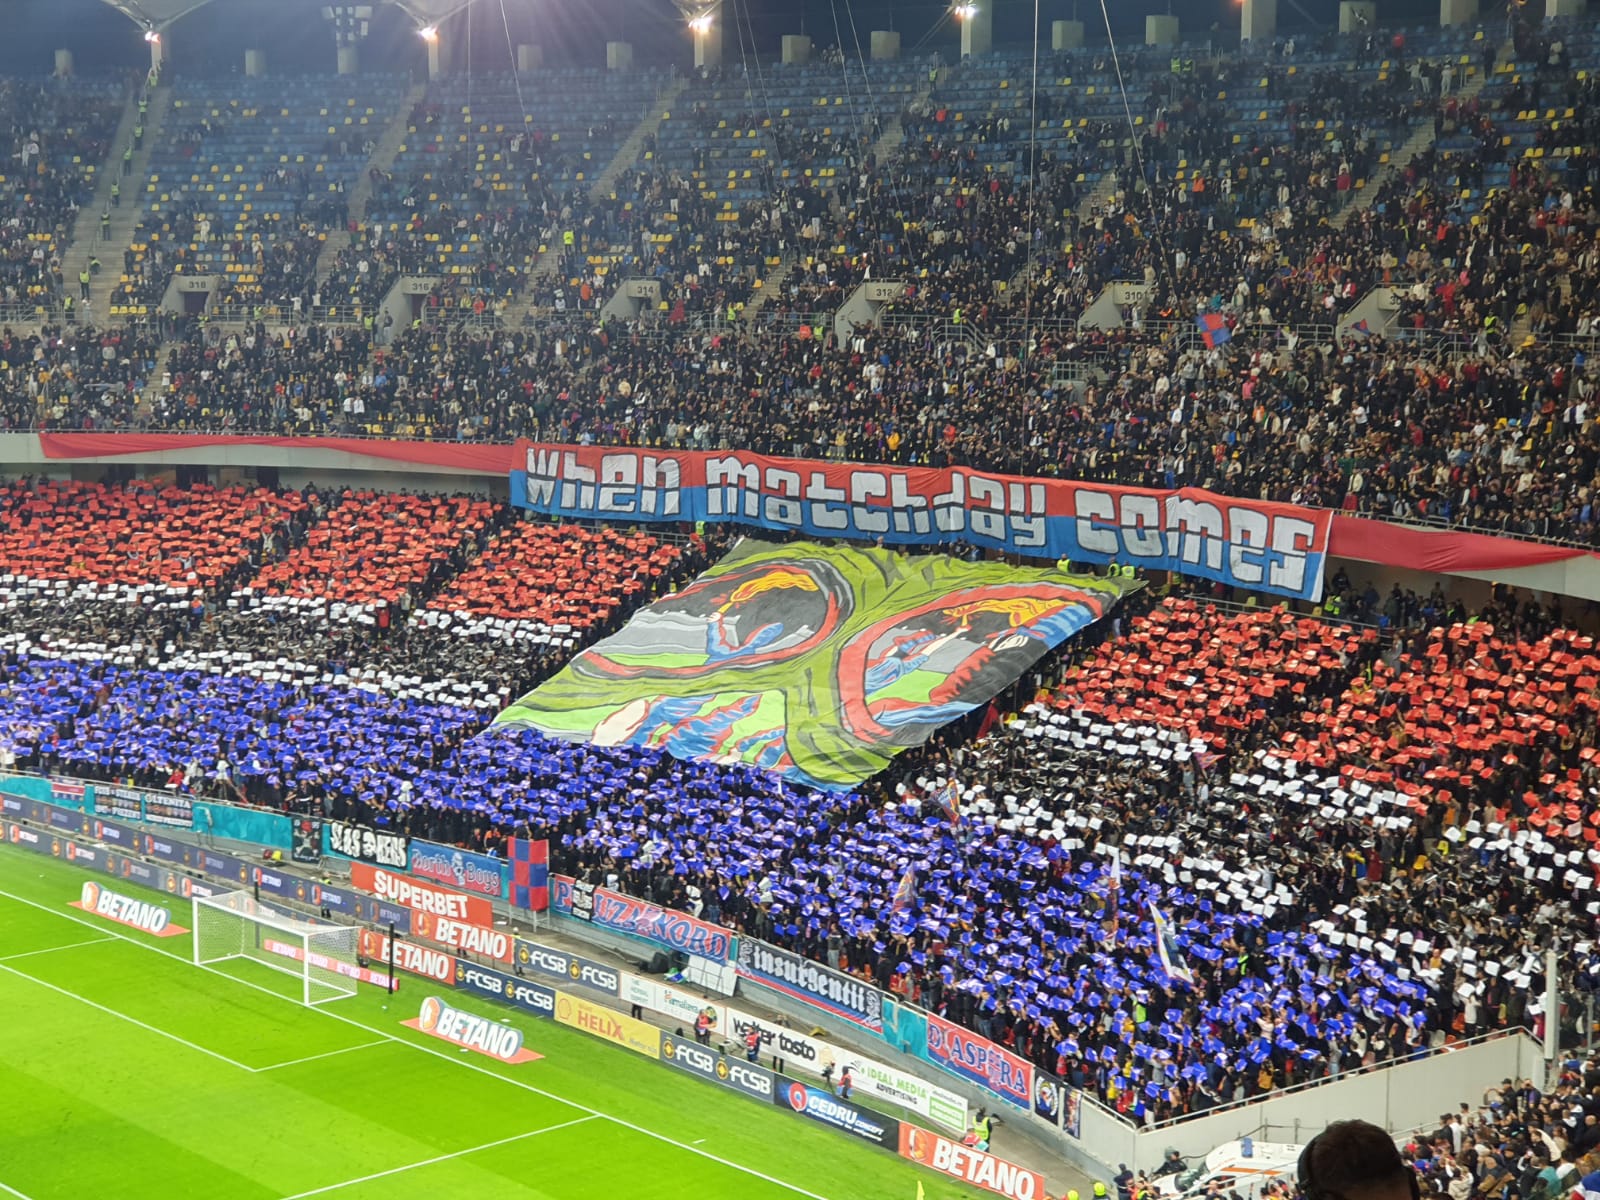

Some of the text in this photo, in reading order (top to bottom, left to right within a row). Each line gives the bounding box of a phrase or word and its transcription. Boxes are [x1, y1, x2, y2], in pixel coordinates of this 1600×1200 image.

[876, 288, 893, 297] 312
[1125, 291, 1142, 300] 310
[97, 890, 168, 932] BETANO
[374, 870, 468, 919] SUPERBET
[435, 918, 507, 958] BETANO
[651, 911, 728, 961] NORD
[381, 937, 449, 980] BETANO
[529, 950, 618, 990] FCSB FCSB
[465, 969, 553, 1011] FCSB FCSB
[437, 1006, 519, 1058] BETANO
[577, 1010, 625, 1041] HELIX
[778, 1032, 816, 1061] tosto
[675, 1044, 714, 1073] FCSB
[728, 1065, 771, 1095] FCSB
[896, 1078, 927, 1099] MEDIA
[808, 1095, 858, 1125] CEDRU
[933, 1138, 1035, 1200] BETANO
